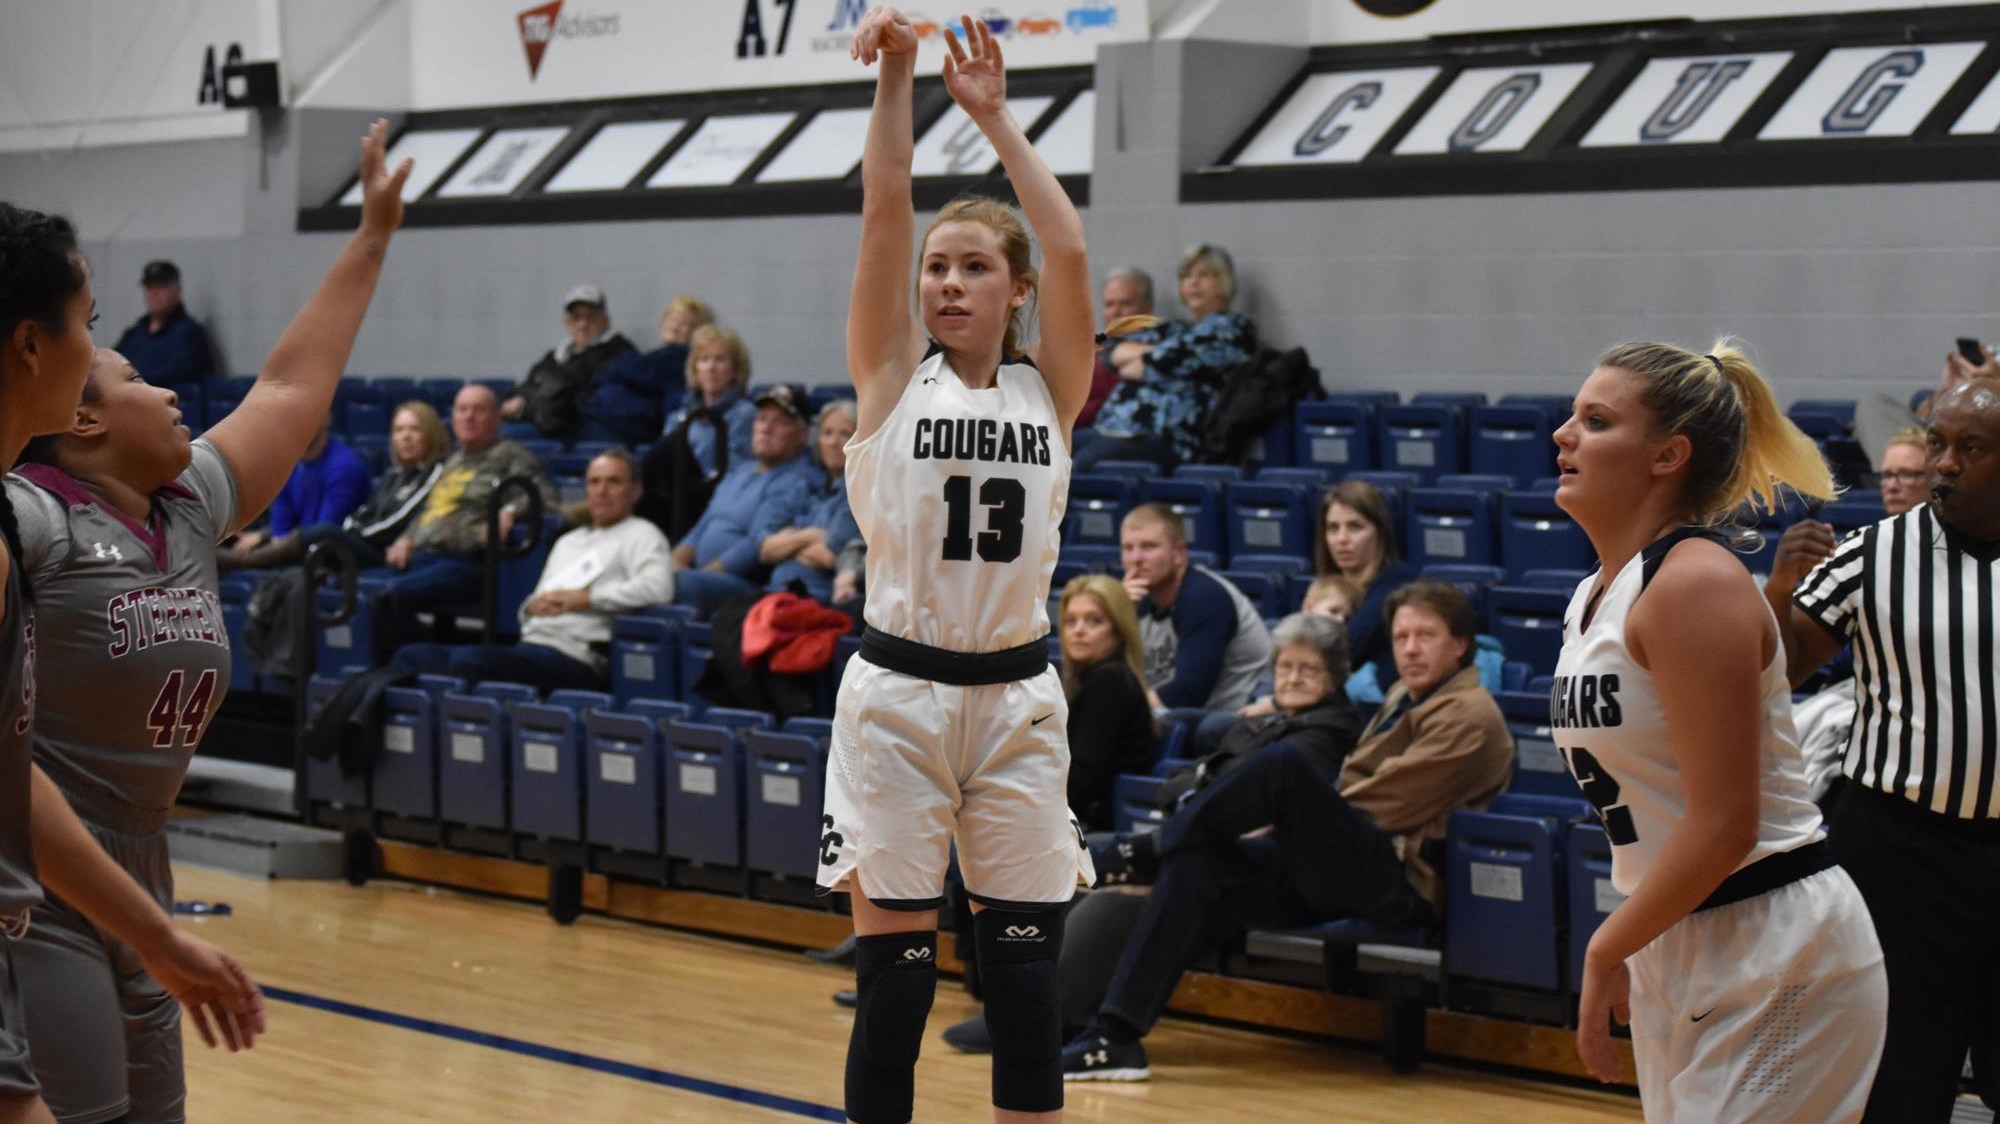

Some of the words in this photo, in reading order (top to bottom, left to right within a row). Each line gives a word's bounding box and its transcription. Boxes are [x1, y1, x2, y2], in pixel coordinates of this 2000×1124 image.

[736, 0, 795, 58] A7
[913, 418, 1051, 466] COUGARS
[942, 475, 1025, 563] 13
[147, 669, 217, 748] 44
[1551, 673, 1623, 729] UGARS
[1559, 746, 1640, 847] 2
